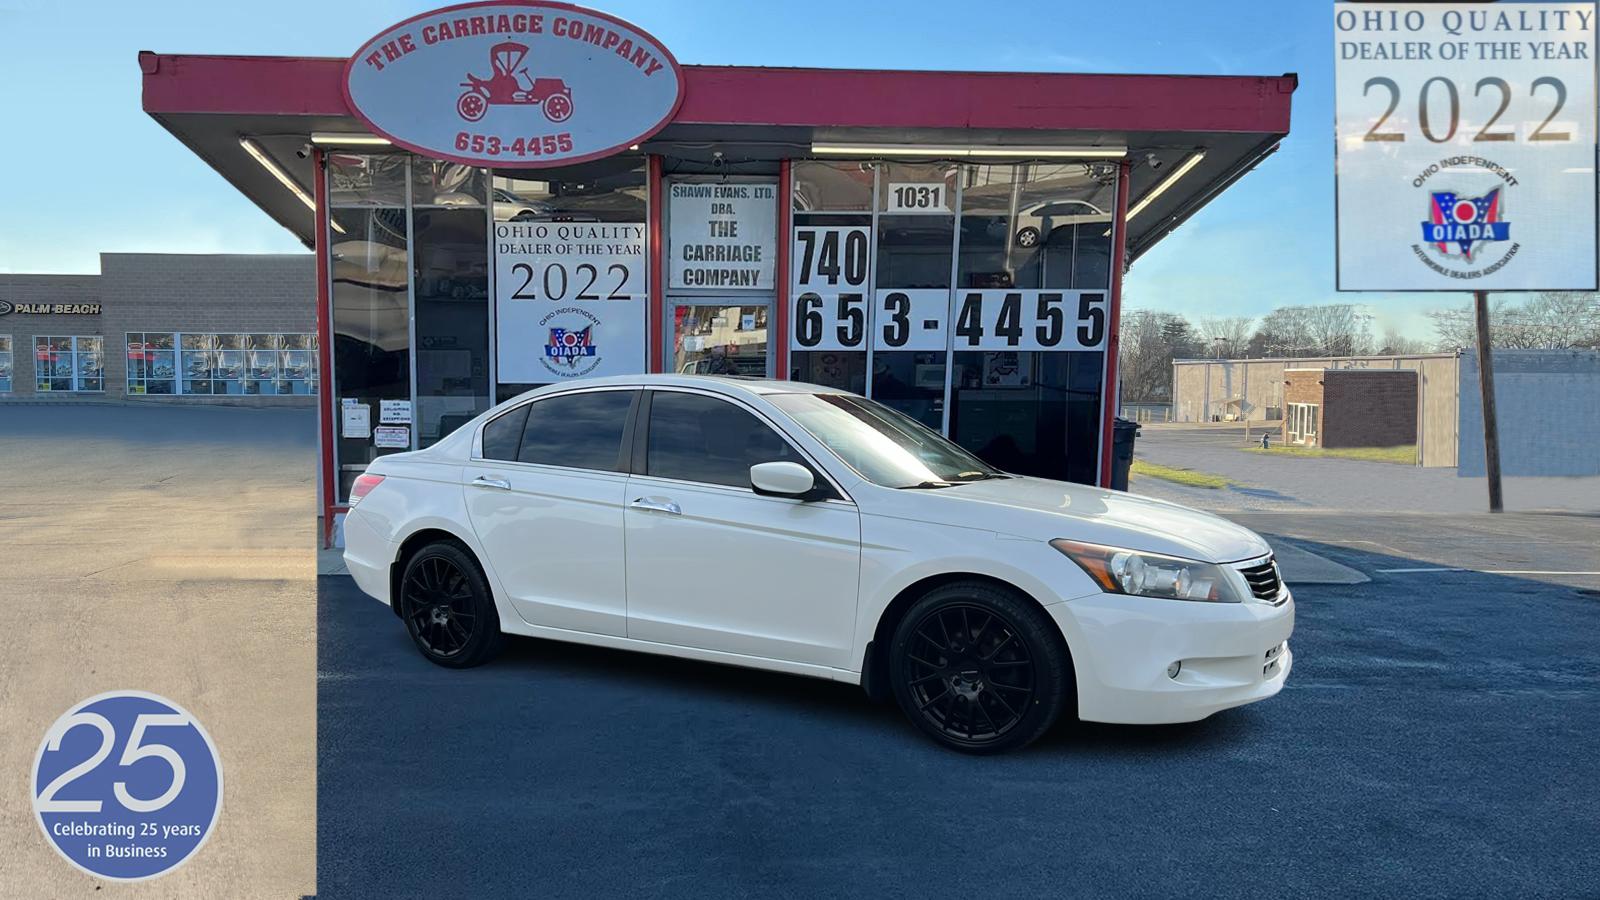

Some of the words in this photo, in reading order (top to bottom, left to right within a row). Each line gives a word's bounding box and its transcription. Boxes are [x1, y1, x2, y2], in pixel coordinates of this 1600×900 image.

[1336, 10, 1425, 31] OHIO
[1442, 10, 1592, 35] QUALITY
[366, 34, 417, 71] THE
[422, 14, 543, 46] CARRIAGE
[552, 17, 664, 76] COMPANY
[1340, 42, 1433, 60] DEALER
[1439, 42, 1469, 60] OF
[1475, 42, 1522, 59] THE
[1528, 42, 1589, 59] YEAR
[1363, 76, 1571, 143] 2022
[455, 132, 574, 156] 653-4455
[1412, 164, 1439, 188] OHIO
[1440, 155, 1519, 187] INDEPENDENT
[673, 186, 711, 198] SHAWN
[754, 187, 775, 199] LTD.
[895, 187, 940, 208] 1031
[497, 226, 548, 239] OHIO
[558, 226, 644, 240] QUALITY
[709, 221, 738, 238] THE
[1432, 224, 1495, 240] OIADA
[500, 244, 551, 254] DEALER
[555, 244, 573, 254] OF
[576, 244, 603, 254] THE
[607, 244, 641, 255] YEAR
[683, 245, 762, 262] CARRIAGE
[797, 230, 868, 287] 740
[511, 263, 631, 301] 2022
[683, 269, 760, 286] COMPANY
[15, 304, 51, 314] PALM
[55, 304, 100, 314] BEACH
[539, 312, 555, 327] OHIO
[555, 307, 602, 327] INDEPENDENT
[551, 346, 587, 356] OIADA
